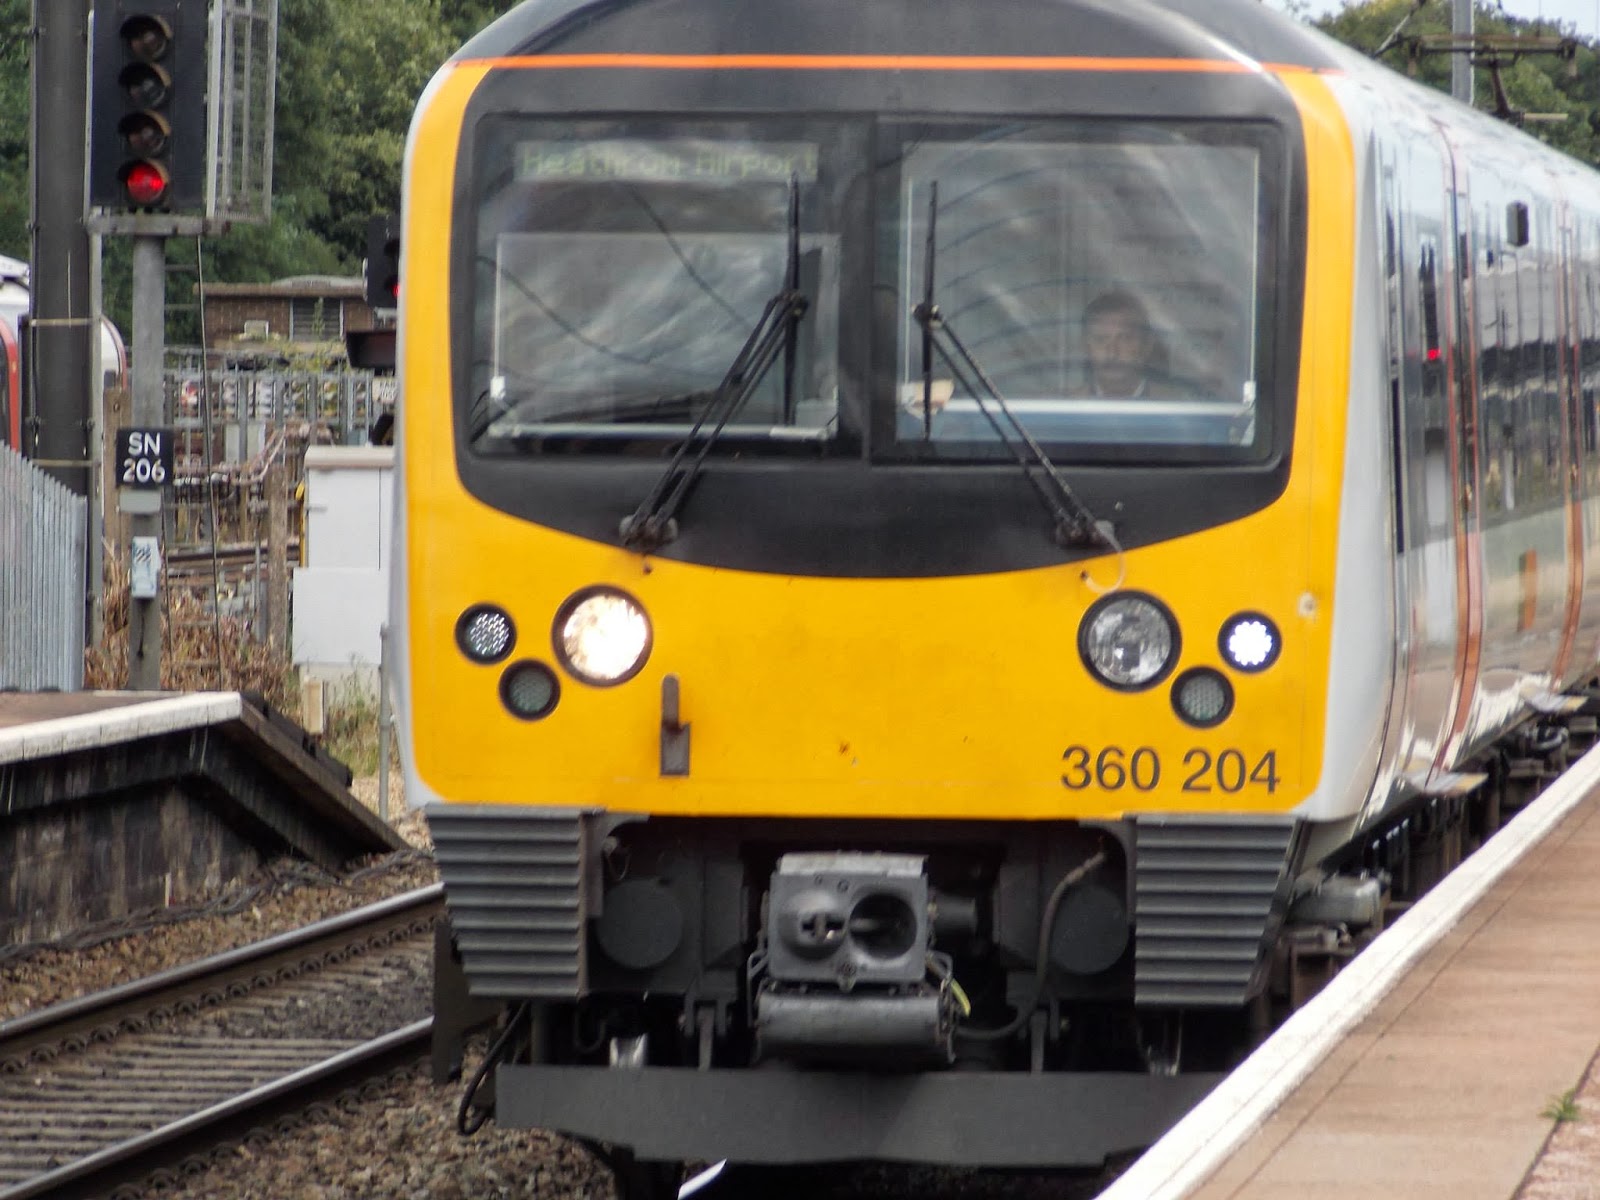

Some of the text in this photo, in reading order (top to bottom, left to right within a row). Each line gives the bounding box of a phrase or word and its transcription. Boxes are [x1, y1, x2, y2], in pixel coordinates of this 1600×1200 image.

[128, 431, 161, 457] SN
[122, 457, 166, 484] 206
[1061, 744, 1282, 795] 360 204
